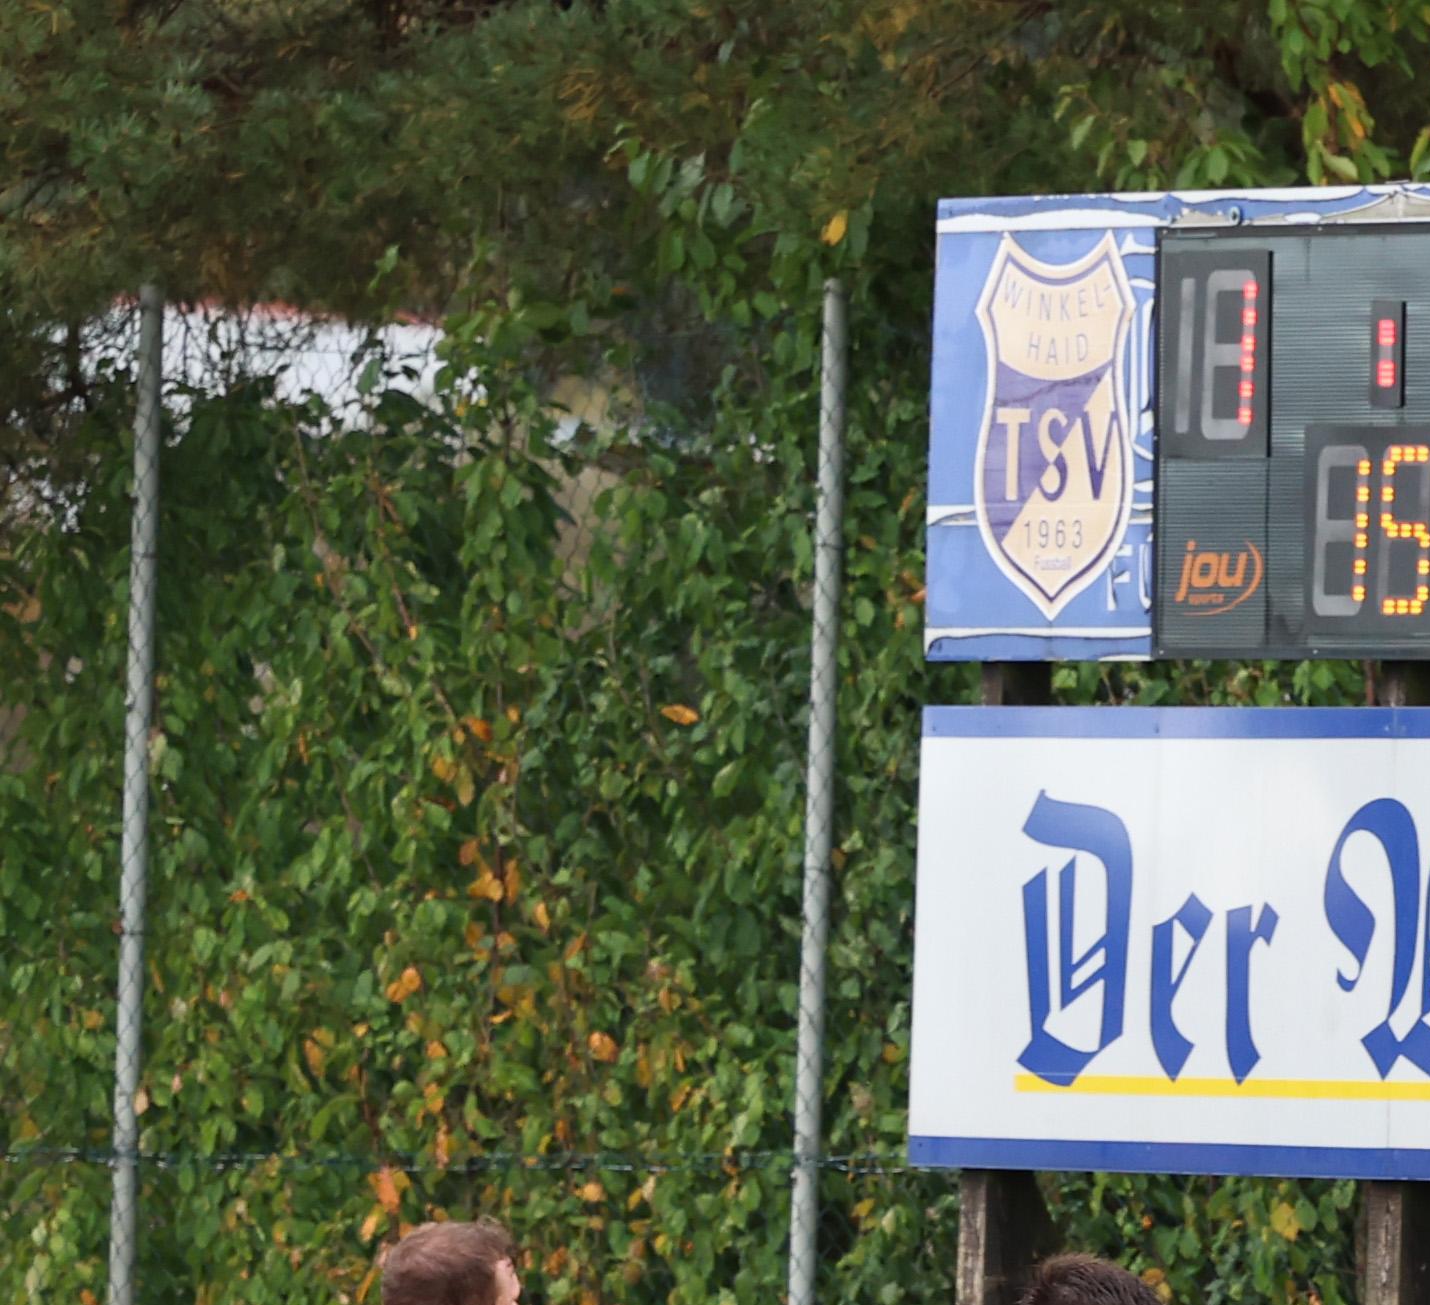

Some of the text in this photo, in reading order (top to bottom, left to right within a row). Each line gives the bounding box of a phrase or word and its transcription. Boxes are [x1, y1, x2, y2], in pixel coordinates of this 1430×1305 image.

[1027, 333, 1089, 365] HAID
[996, 407, 1116, 502] TSV
[1023, 519, 1082, 549] 1963
[1016, 788, 1279, 1086] Der
